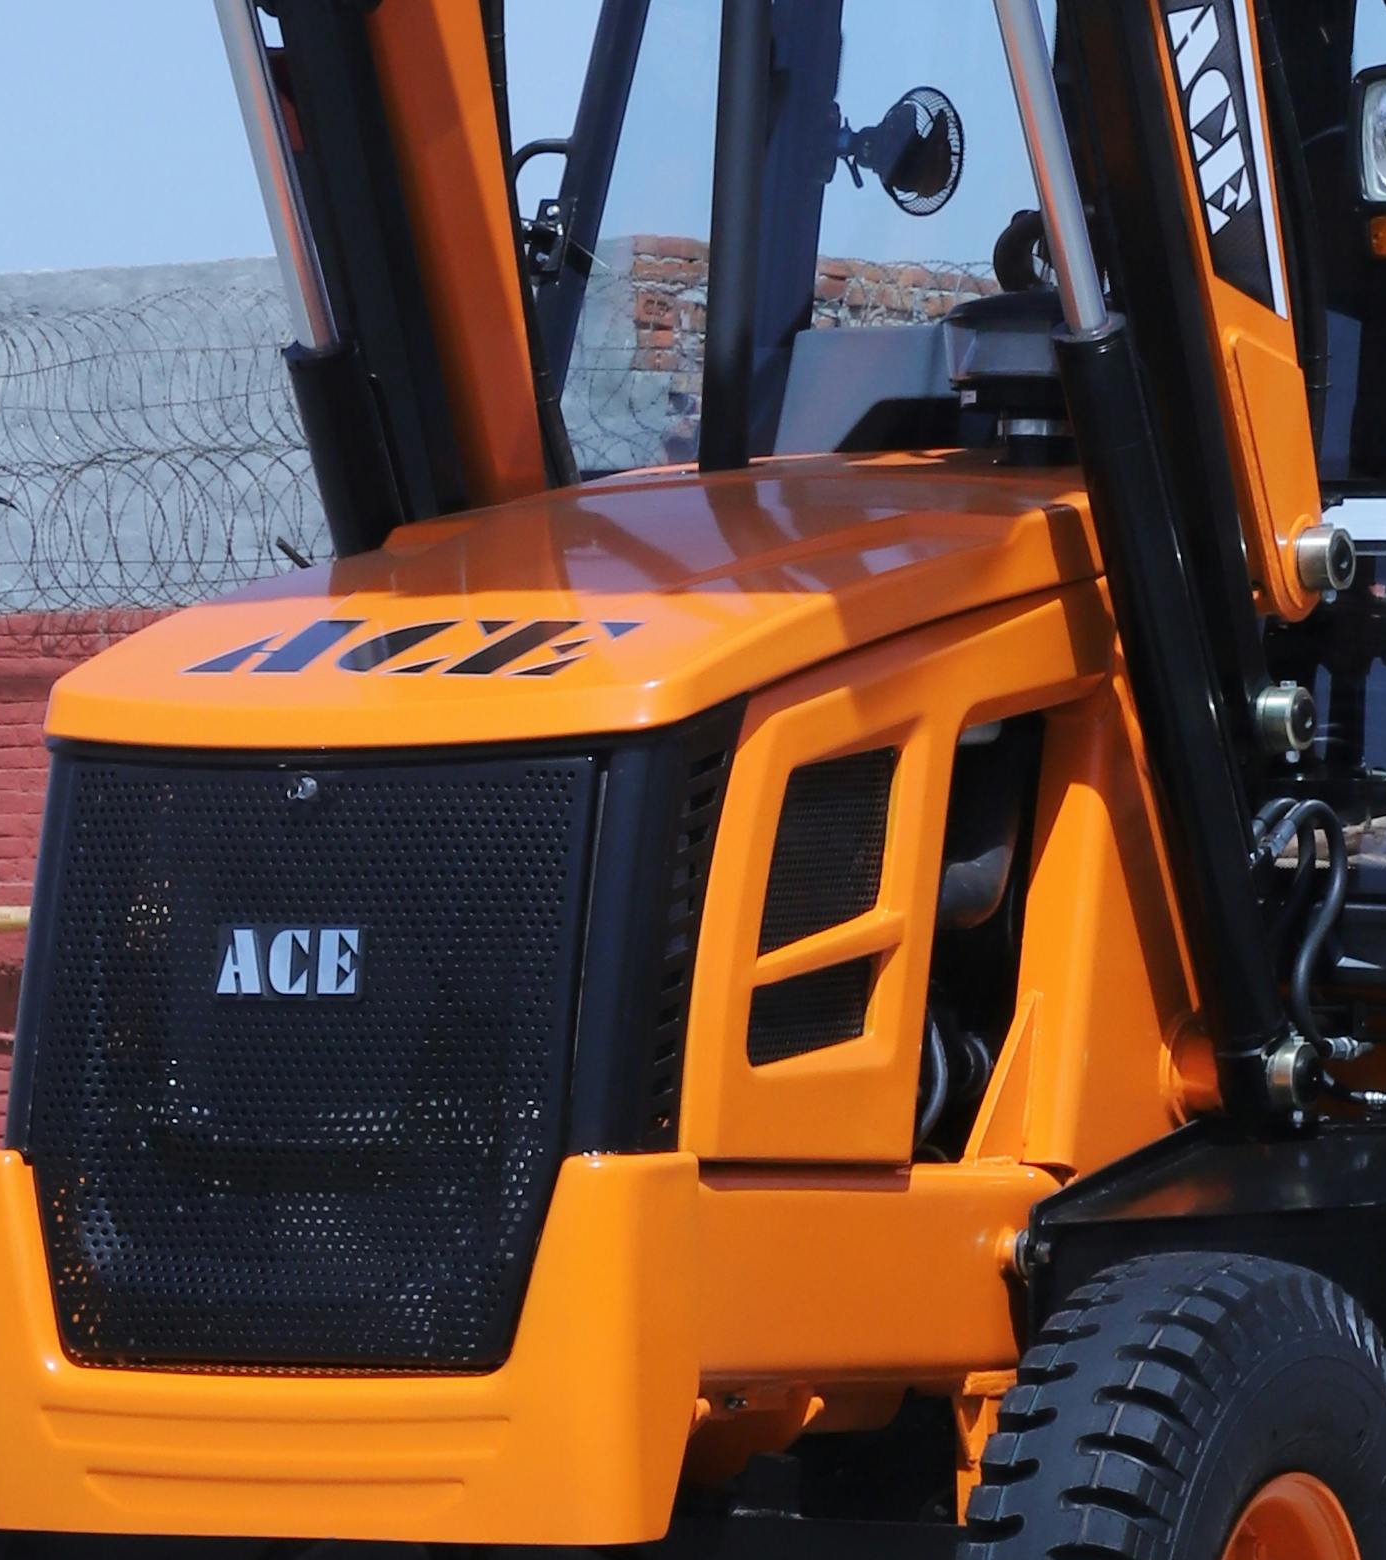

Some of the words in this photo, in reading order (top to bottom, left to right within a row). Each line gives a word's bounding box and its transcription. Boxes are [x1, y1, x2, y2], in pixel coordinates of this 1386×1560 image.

[1168, 4, 1253, 237] ACE
[181, 618, 647, 677] ACE
[216, 928, 360, 996] ACE
